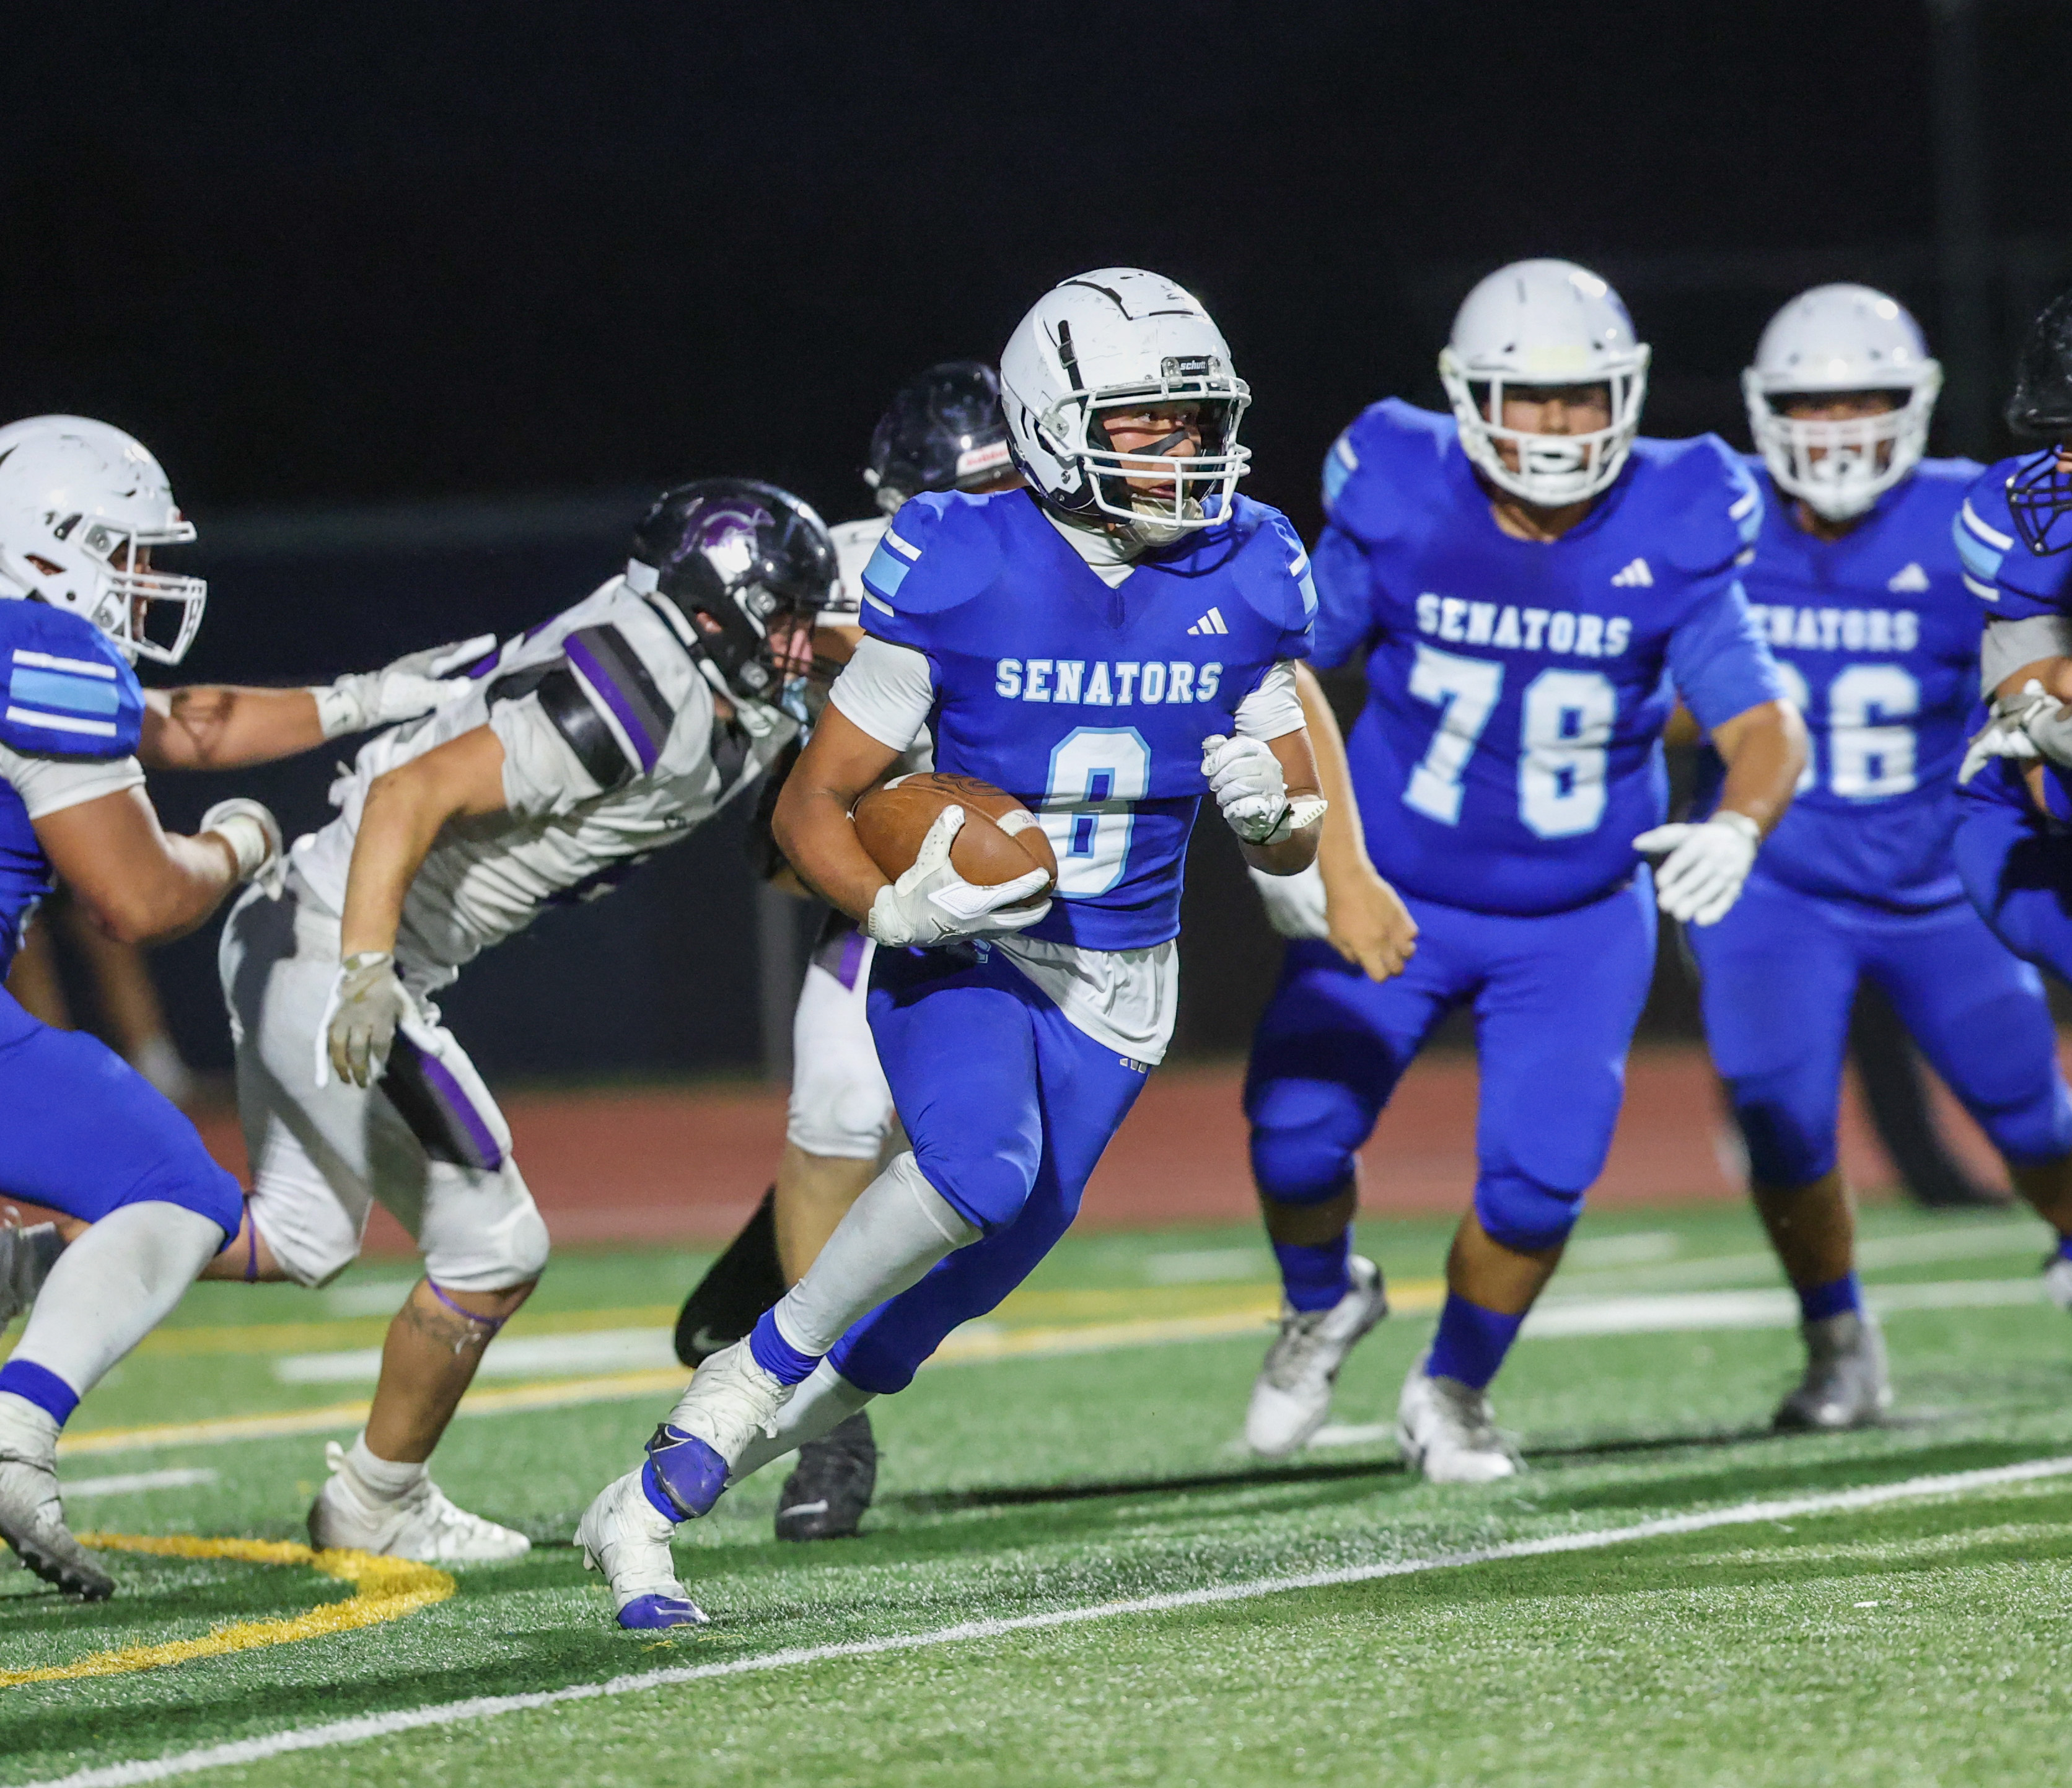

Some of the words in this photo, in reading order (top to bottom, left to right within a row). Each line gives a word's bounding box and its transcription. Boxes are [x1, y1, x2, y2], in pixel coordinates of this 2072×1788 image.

[1180, 359, 1206, 370] schutt
[1415, 592, 1633, 657] SENATORS
[994, 657, 1224, 706] SENATORS
[1401, 641, 1618, 841] 78
[1035, 725, 1151, 898] 8
